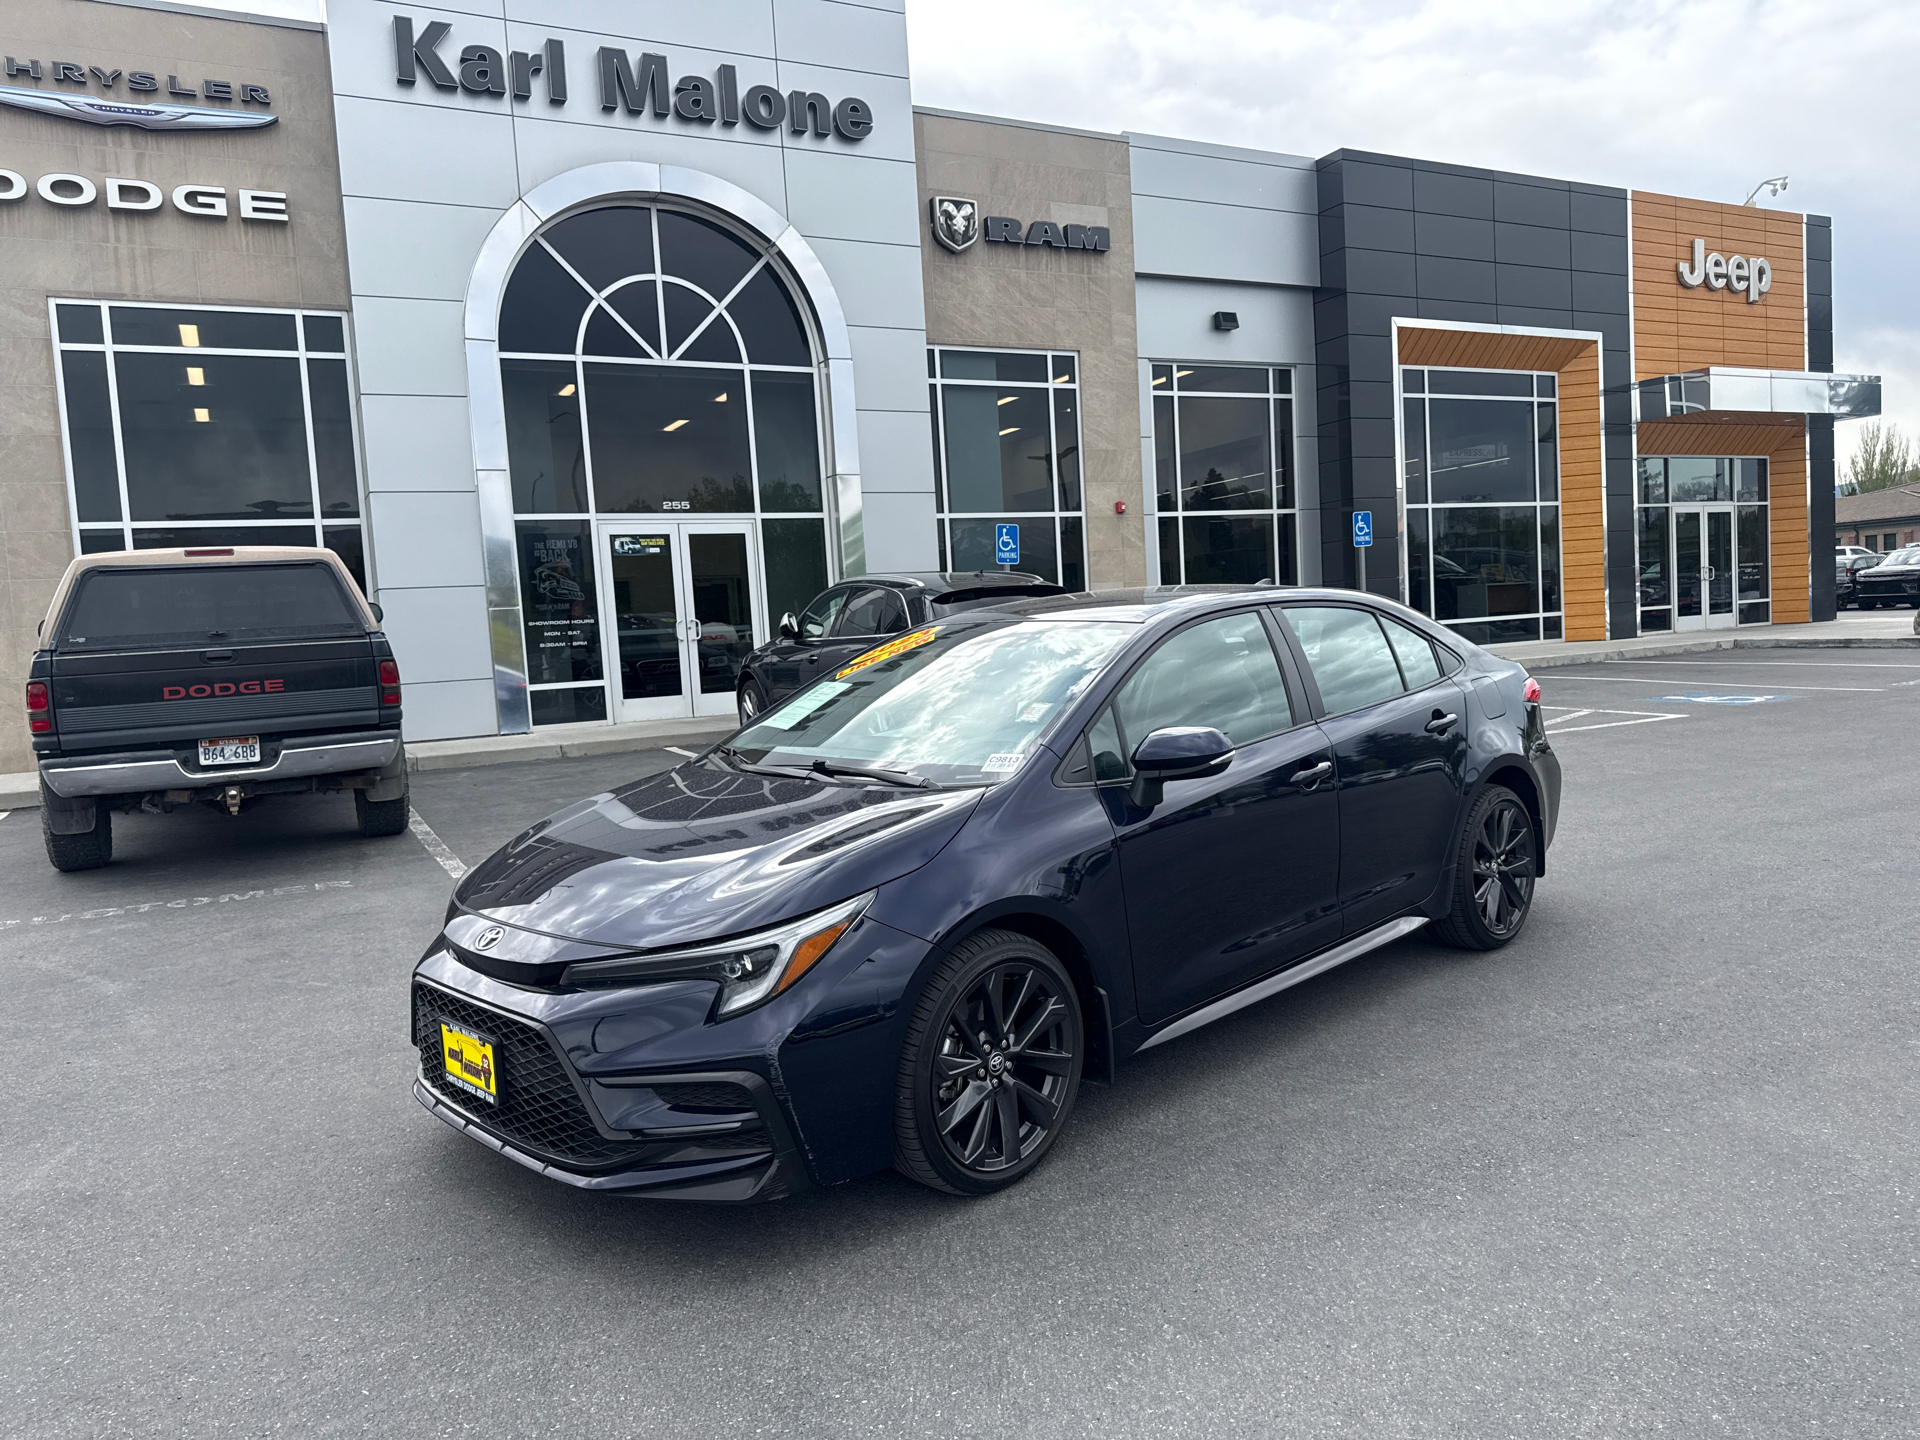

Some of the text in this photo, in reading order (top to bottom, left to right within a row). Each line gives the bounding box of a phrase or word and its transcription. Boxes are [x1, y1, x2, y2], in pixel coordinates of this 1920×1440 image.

[4, 55, 271, 105] HRYSLER
[392, 14, 874, 142] Karl Malone
[94, 105, 155, 115] CHRYSLER
[984, 216, 1111, 253] RAM
[1677, 238, 1772, 304] Jeep
[662, 501, 690, 510] 255
[546, 539, 566, 549] HEMI
[567, 539, 578, 549] V8
[540, 549, 569, 562] BACK
[998, 551, 1017, 559] PARKING
[887, 637, 931, 657] NEW
[163, 679, 284, 700] DODGE
[203, 744, 256, 761] B64 6BB
[445, 1072, 494, 1105] CHRYSLER DODGE JEEP RAM
